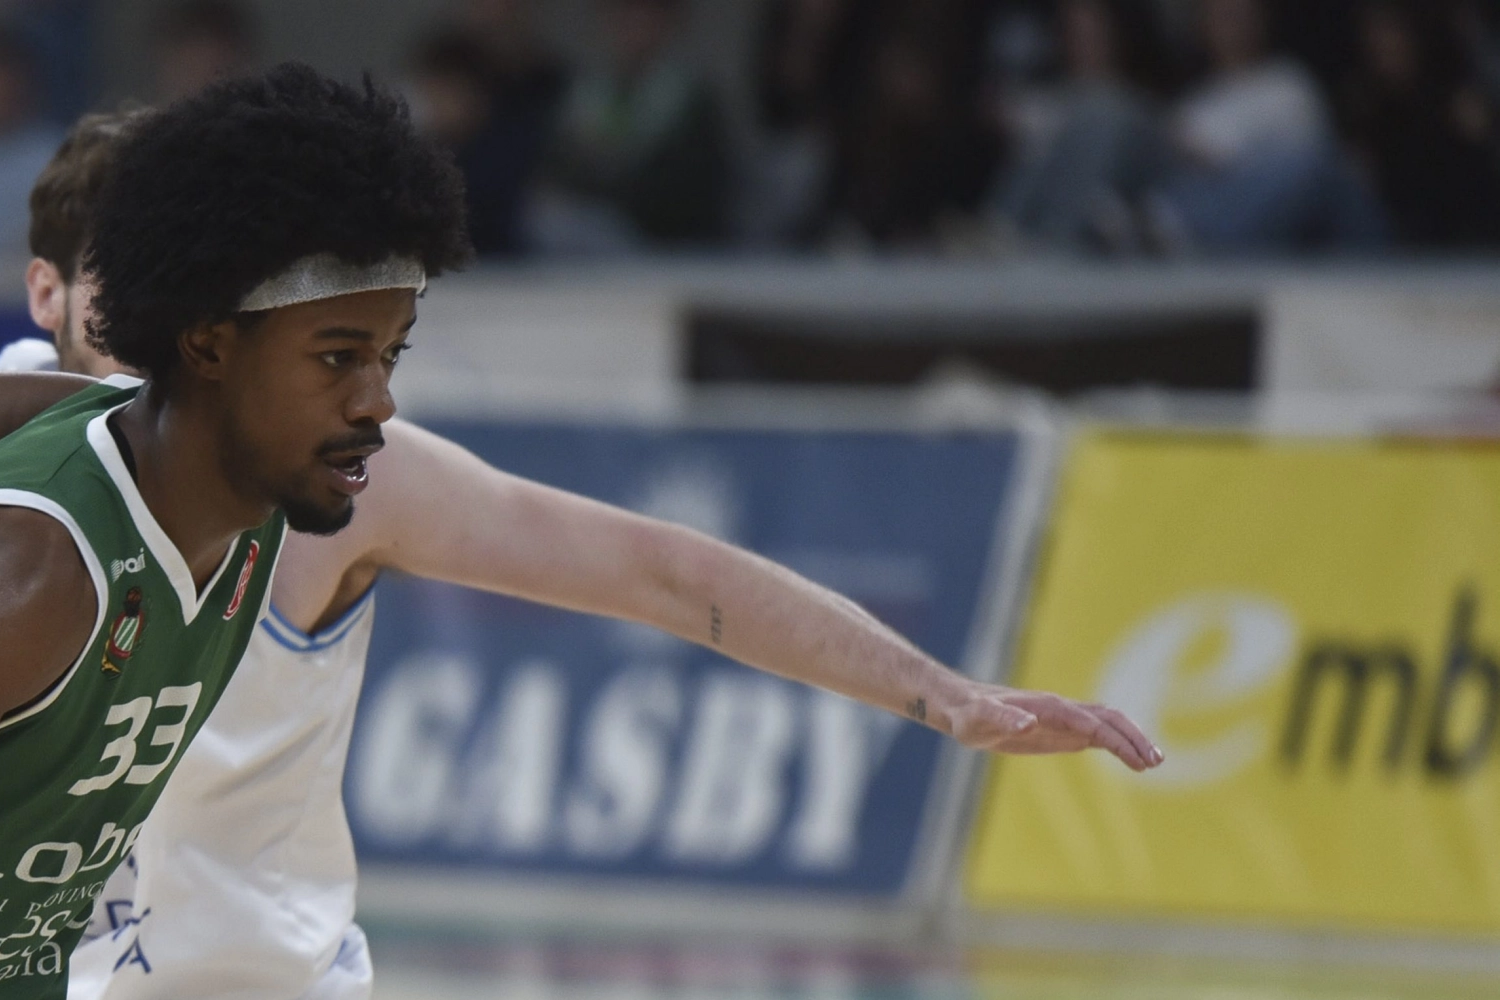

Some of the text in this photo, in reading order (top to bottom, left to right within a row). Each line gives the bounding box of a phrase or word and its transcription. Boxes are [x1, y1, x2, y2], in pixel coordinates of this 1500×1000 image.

[67, 681, 203, 797] 33
[358, 653, 908, 873] GASBY
[23, 880, 107, 920] POVINC
